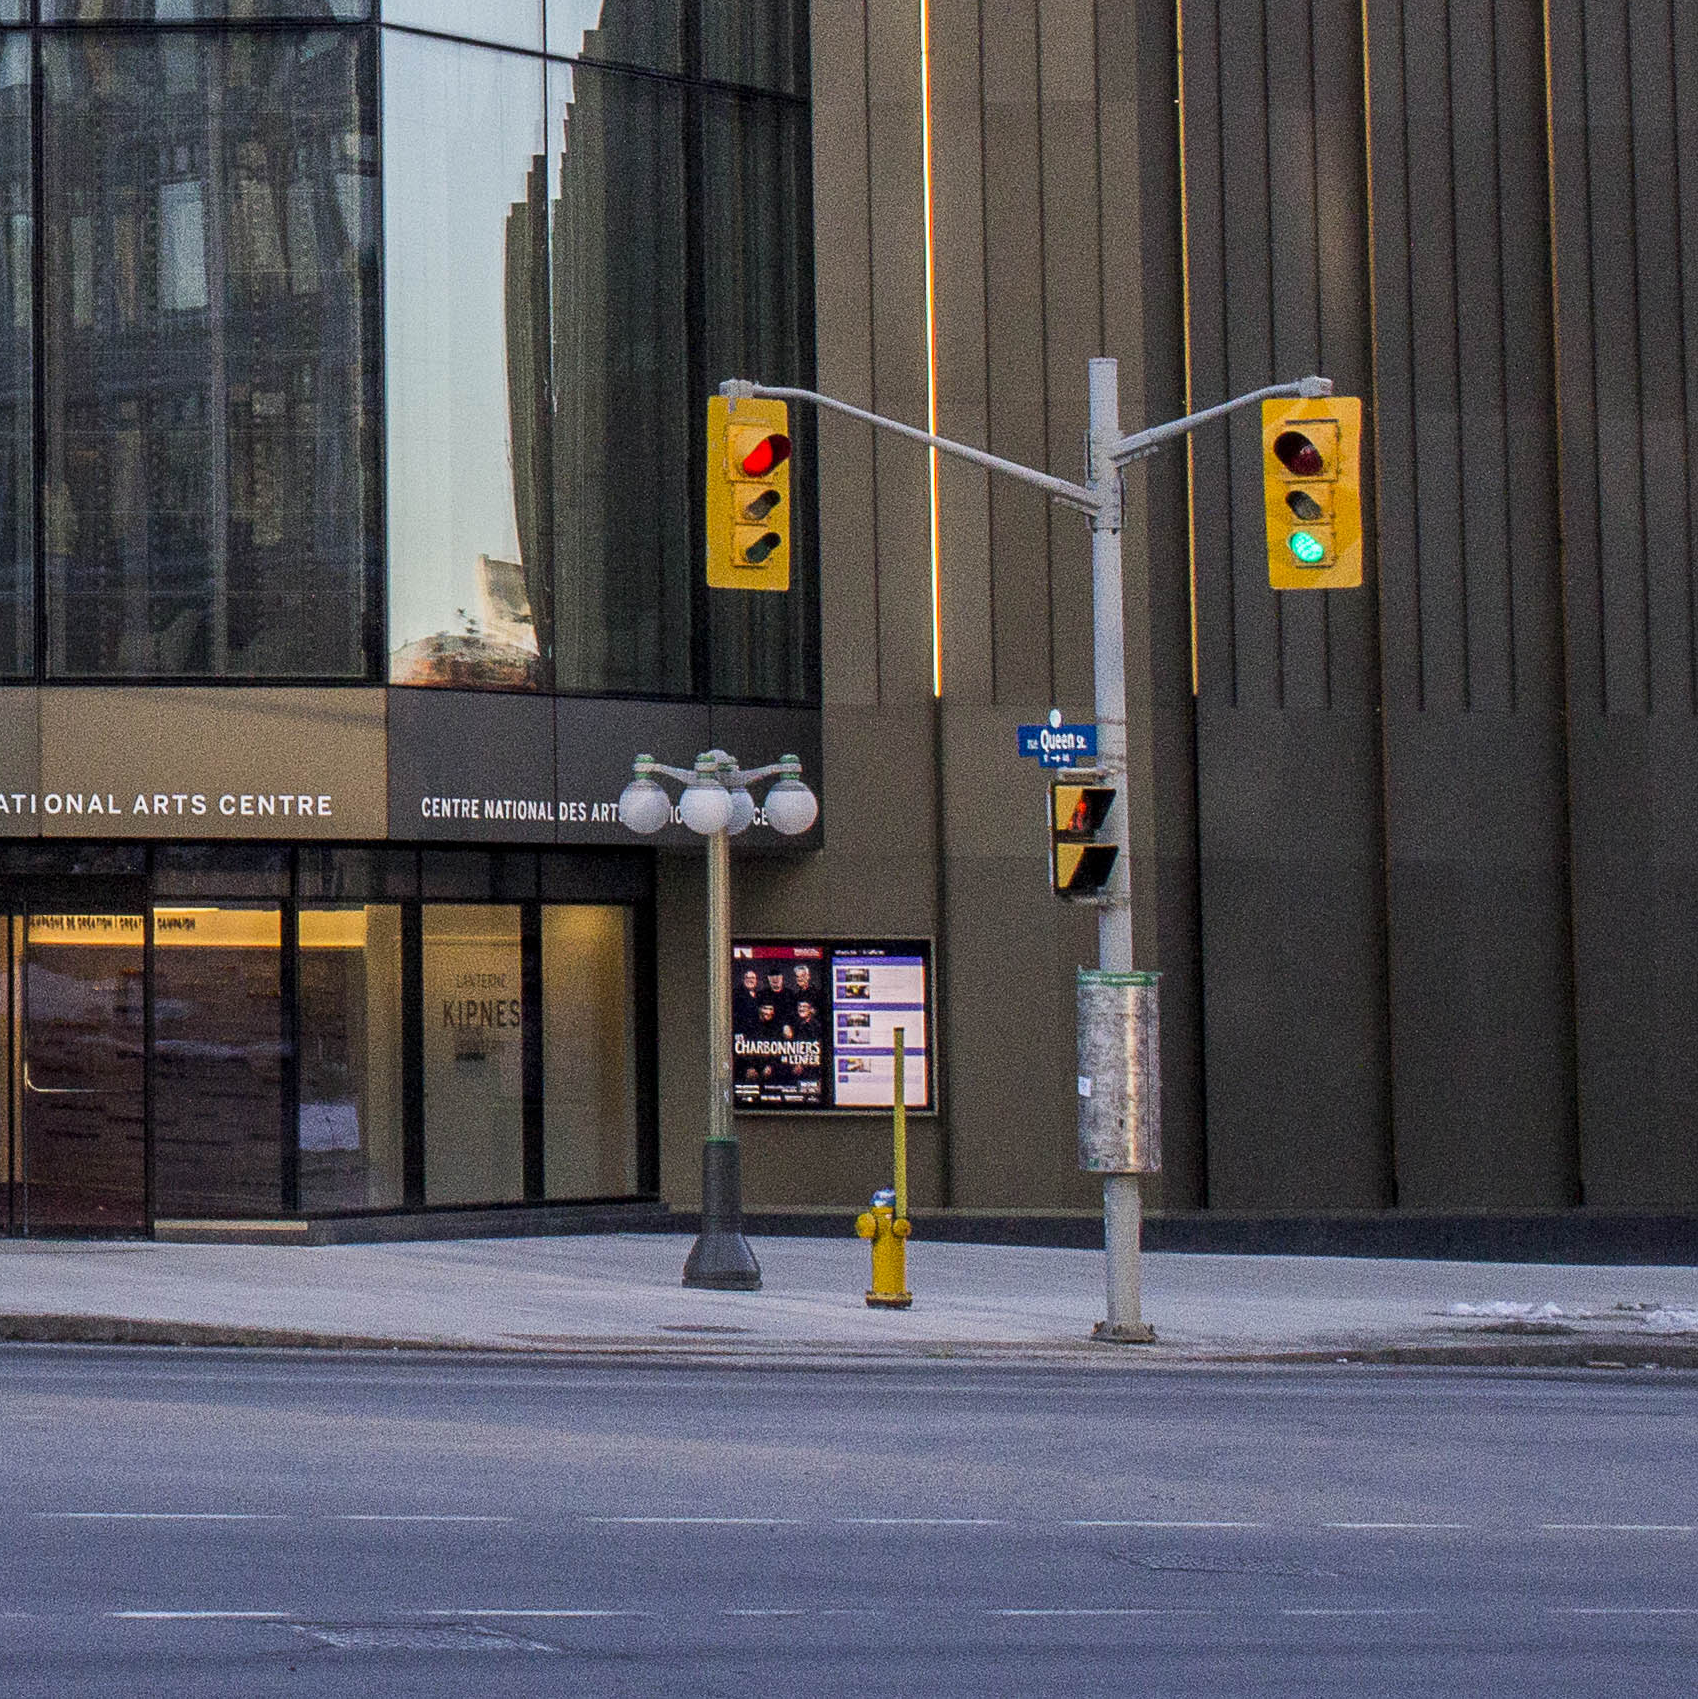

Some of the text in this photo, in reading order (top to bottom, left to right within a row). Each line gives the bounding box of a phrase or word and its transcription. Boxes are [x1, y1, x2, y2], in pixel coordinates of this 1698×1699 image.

[1040, 729, 1075, 752] Queen
[132, 793, 207, 815] ARTS
[218, 794, 333, 816] CENTRE
[421, 797, 622, 822] CENTRE NATIONAL DES ART
[443, 999, 520, 1028] KIPNES
[735, 1041, 821, 1055] CHARBONNIERS
